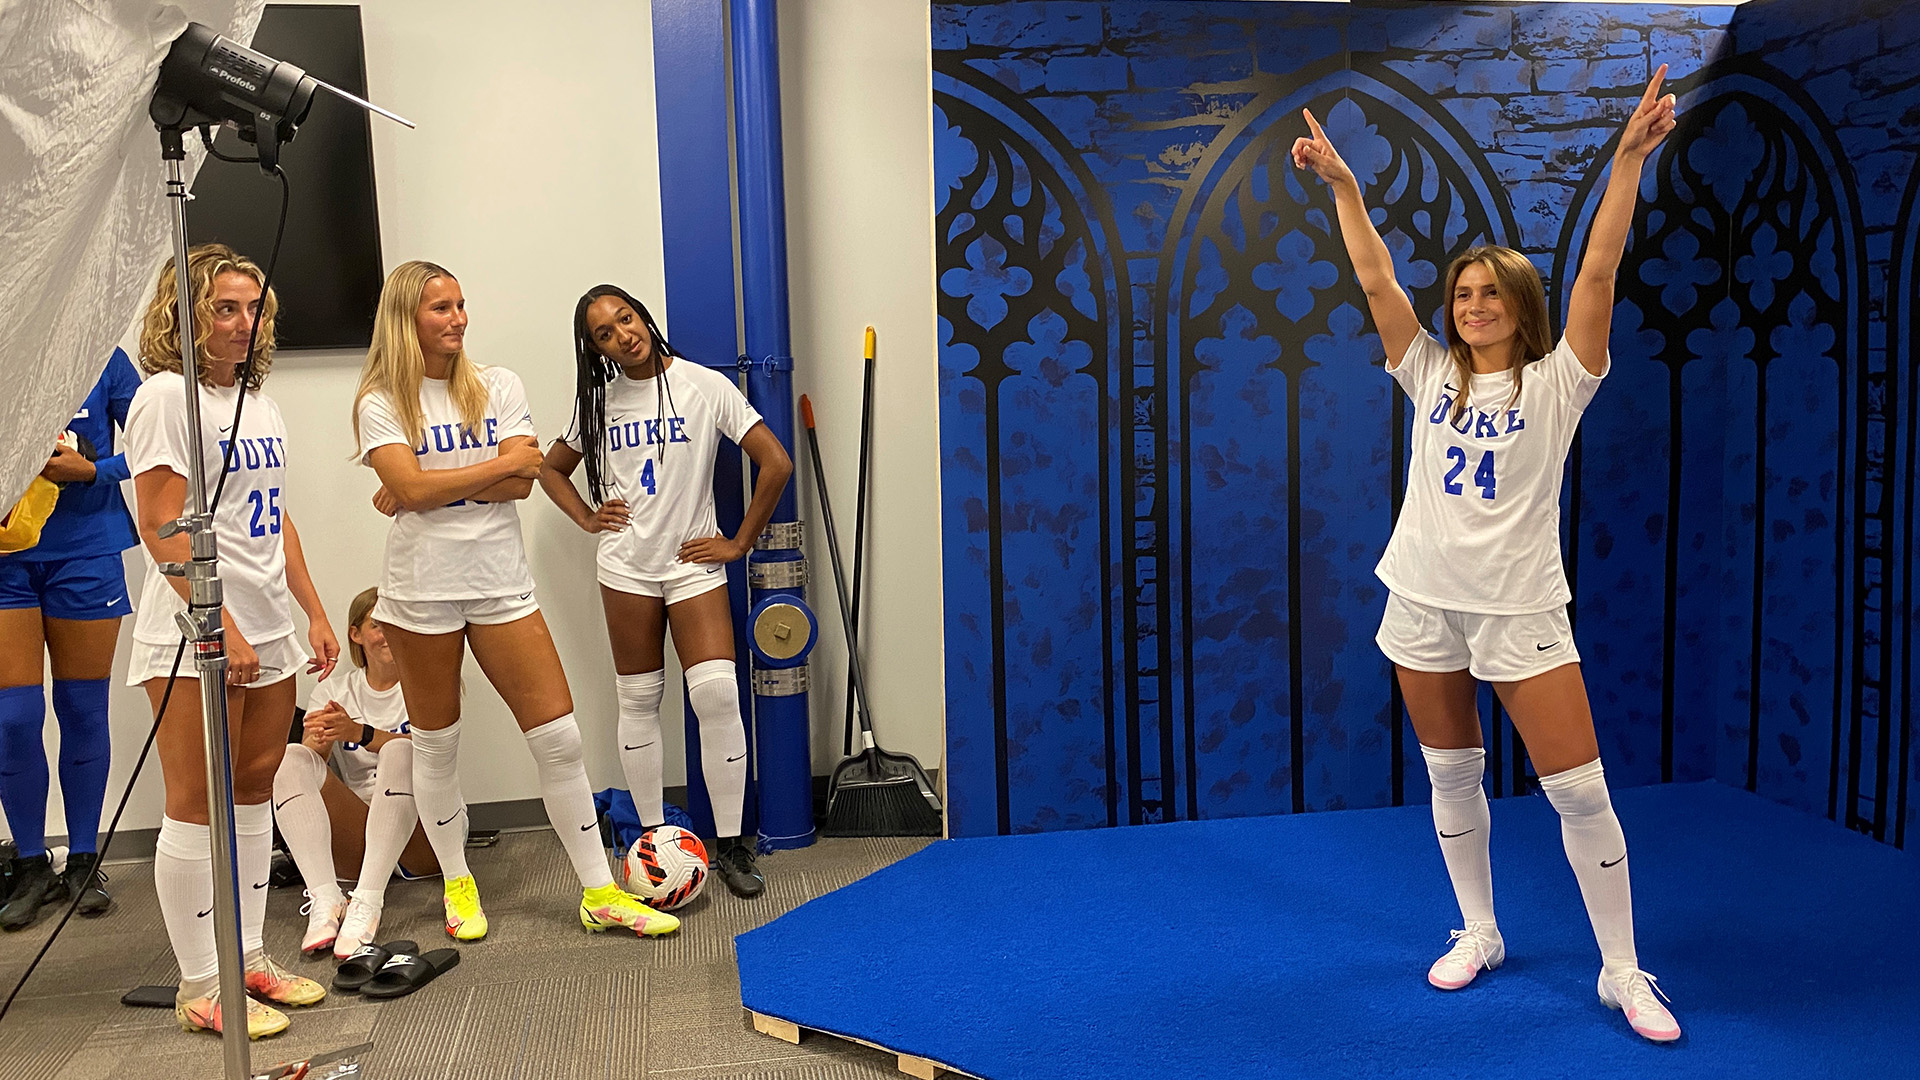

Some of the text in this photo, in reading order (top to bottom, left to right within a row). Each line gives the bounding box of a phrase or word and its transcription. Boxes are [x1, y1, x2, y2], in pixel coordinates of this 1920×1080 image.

[219, 70, 256, 92] Profoto
[608, 416, 687, 452] DUKE
[1429, 393, 1525, 438] DUKE
[218, 436, 286, 473] DUK
[1443, 445, 1496, 500] 24
[640, 458, 656, 495] 4
[247, 487, 281, 538] 25
